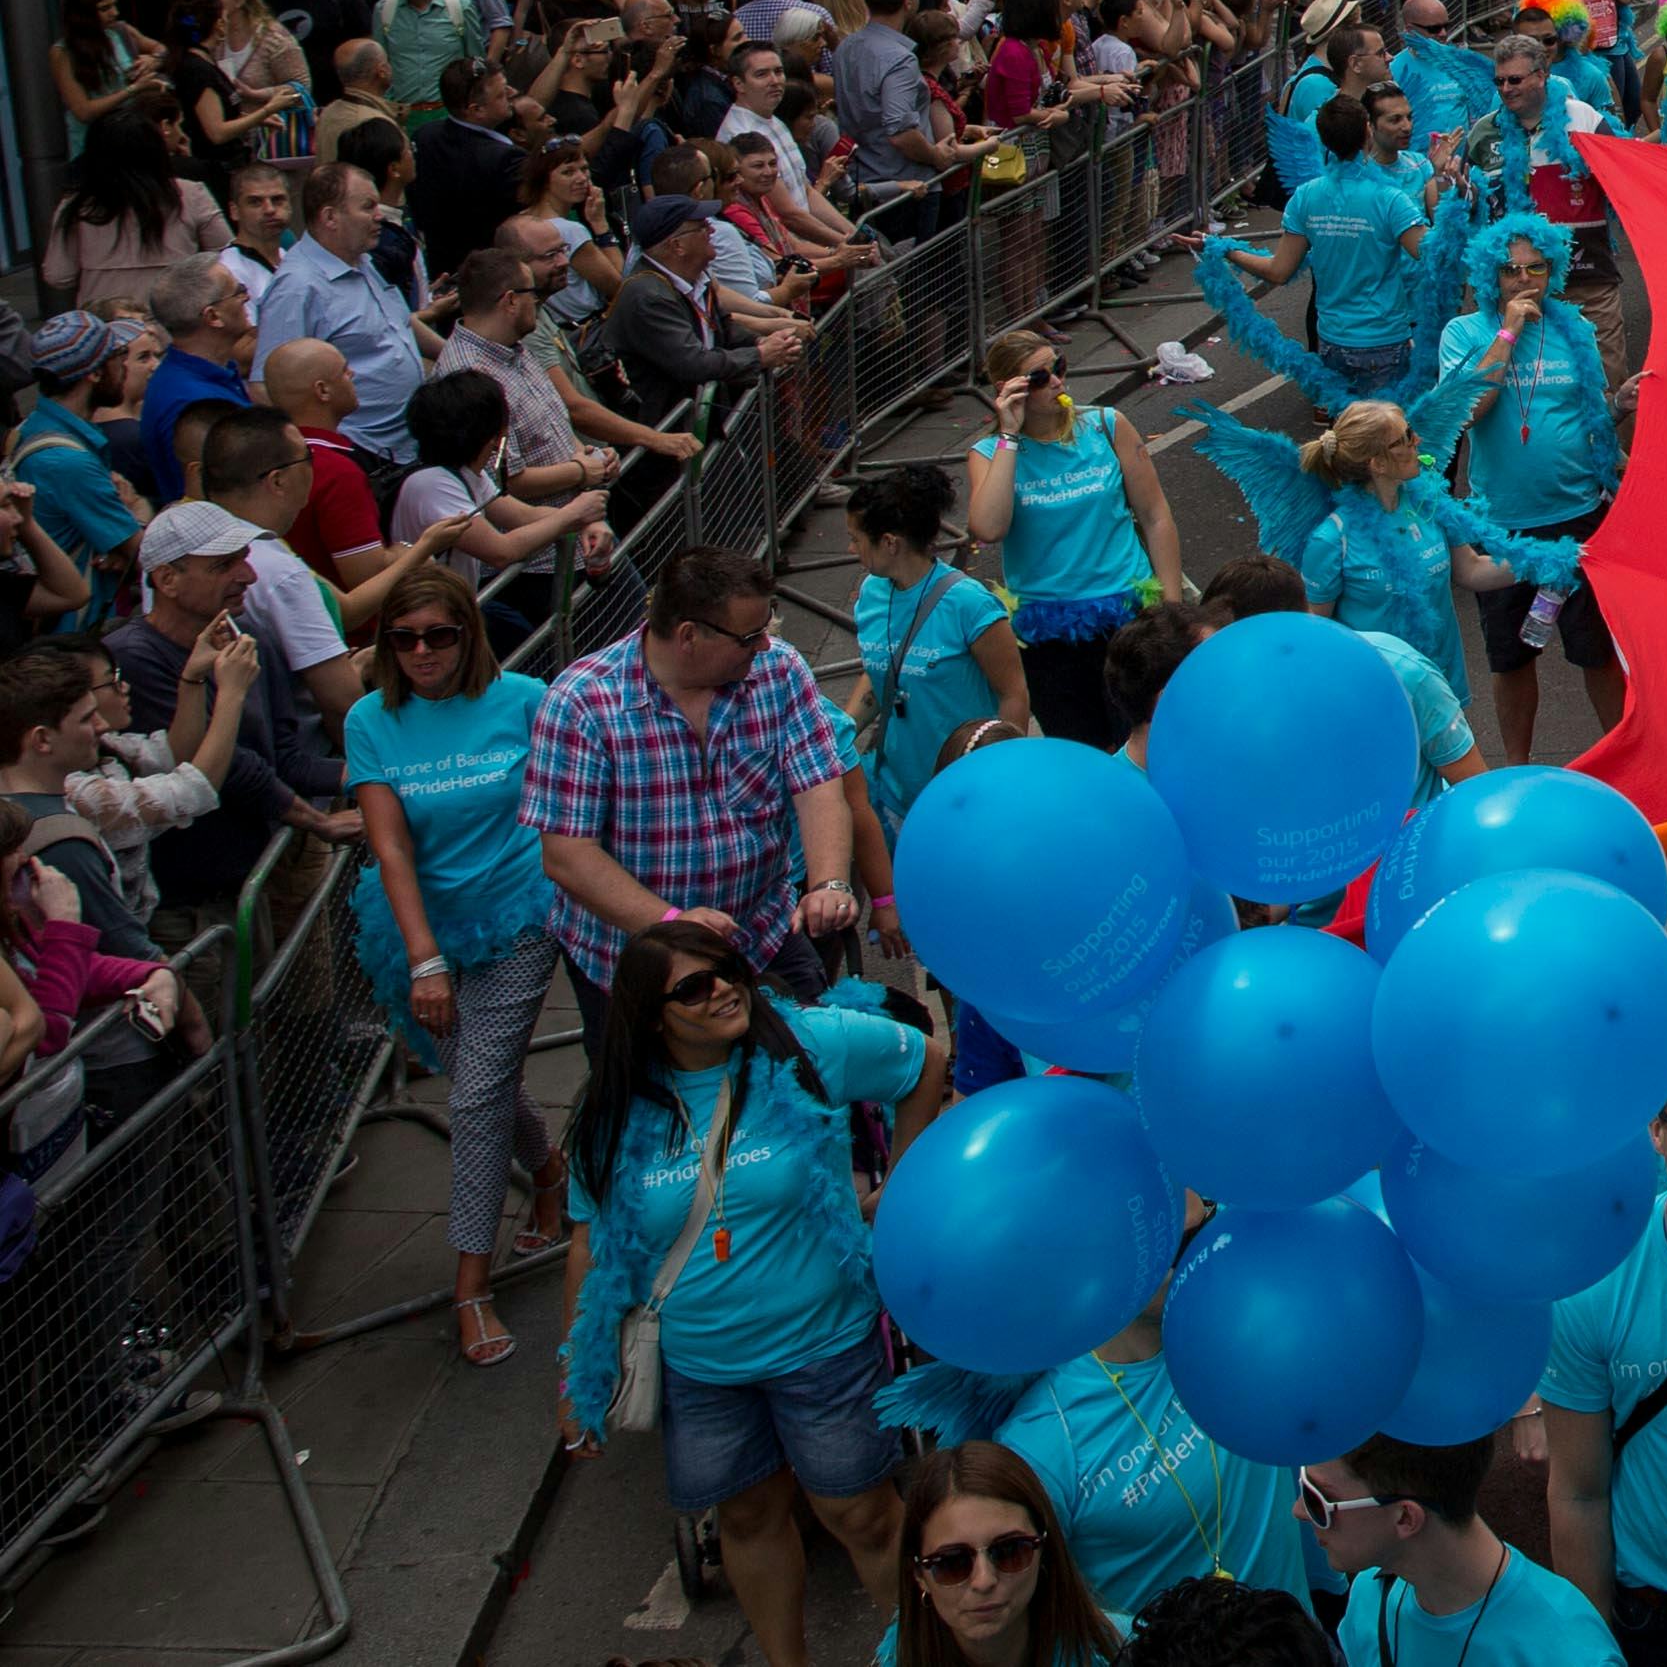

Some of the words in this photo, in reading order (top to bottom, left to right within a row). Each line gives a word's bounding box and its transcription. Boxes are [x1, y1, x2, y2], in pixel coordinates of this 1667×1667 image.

[1021, 481, 1105, 506] #PrideHeroes
[1026, 477, 1047, 490] one
[1050, 472, 1063, 486] of
[886, 640, 901, 654] of
[406, 760, 432, 775] one
[436, 753, 453, 772] of
[456, 743, 520, 769] Barclays'
[399, 768, 508, 797] #PrideHeroes
[1257, 802, 1383, 847] Supporting
[1257, 855, 1287, 871] our
[1302, 838, 1360, 865] 2015
[1042, 871, 1148, 978] Supporting
[1064, 969, 1094, 995] our
[1102, 918, 1148, 966] 2015
[1079, 894, 1177, 1001] #PrideHeroes
[643, 1145, 772, 1190] #Prideeroes
[1079, 1466, 1115, 1499] I'm
[1117, 1434, 1154, 1474] one
